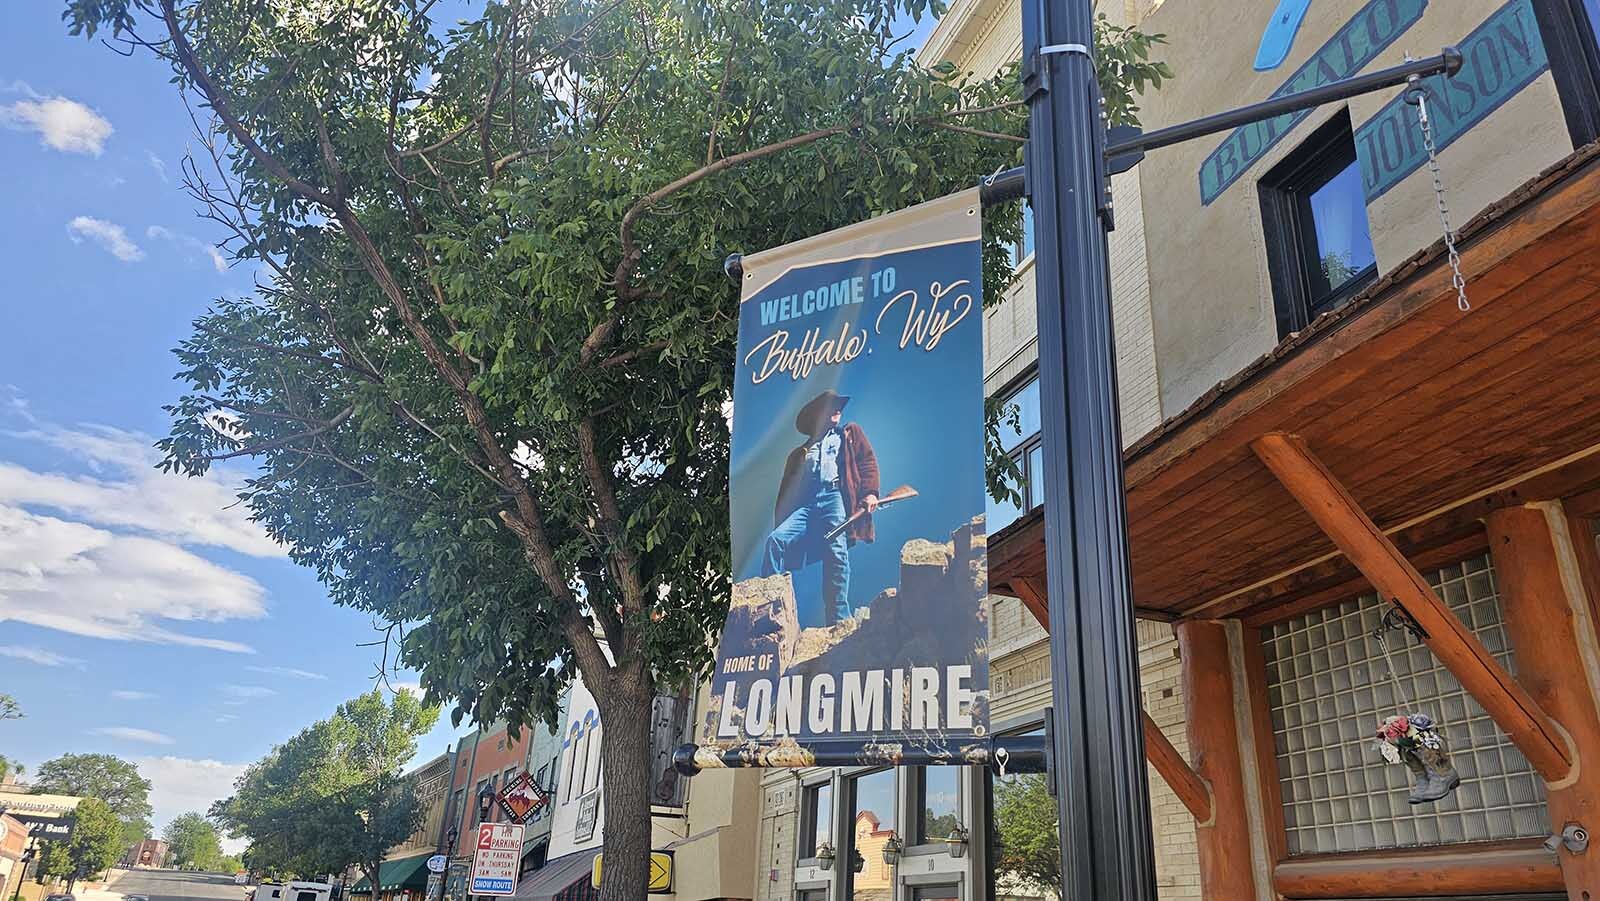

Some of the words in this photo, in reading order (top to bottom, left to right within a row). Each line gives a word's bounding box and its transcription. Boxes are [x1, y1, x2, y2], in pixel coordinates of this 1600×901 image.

[1215, 0, 1400, 188] BUALO
[1359, 6, 1533, 188] JOHNSON
[760, 276, 865, 326] WELCOME
[871, 267, 897, 299] TO
[875, 279, 973, 352] Wy
[722, 655, 756, 675] HOME
[758, 653, 774, 671] OF
[717, 664, 976, 738] LONGMIRE
[45, 823, 70, 834] Bank
[480, 828, 492, 847] 2
[491, 839, 520, 849] PARKING
[493, 852, 514, 860] PARKING
[474, 879, 493, 889] SNOW
[493, 880, 513, 890] ROUTE
